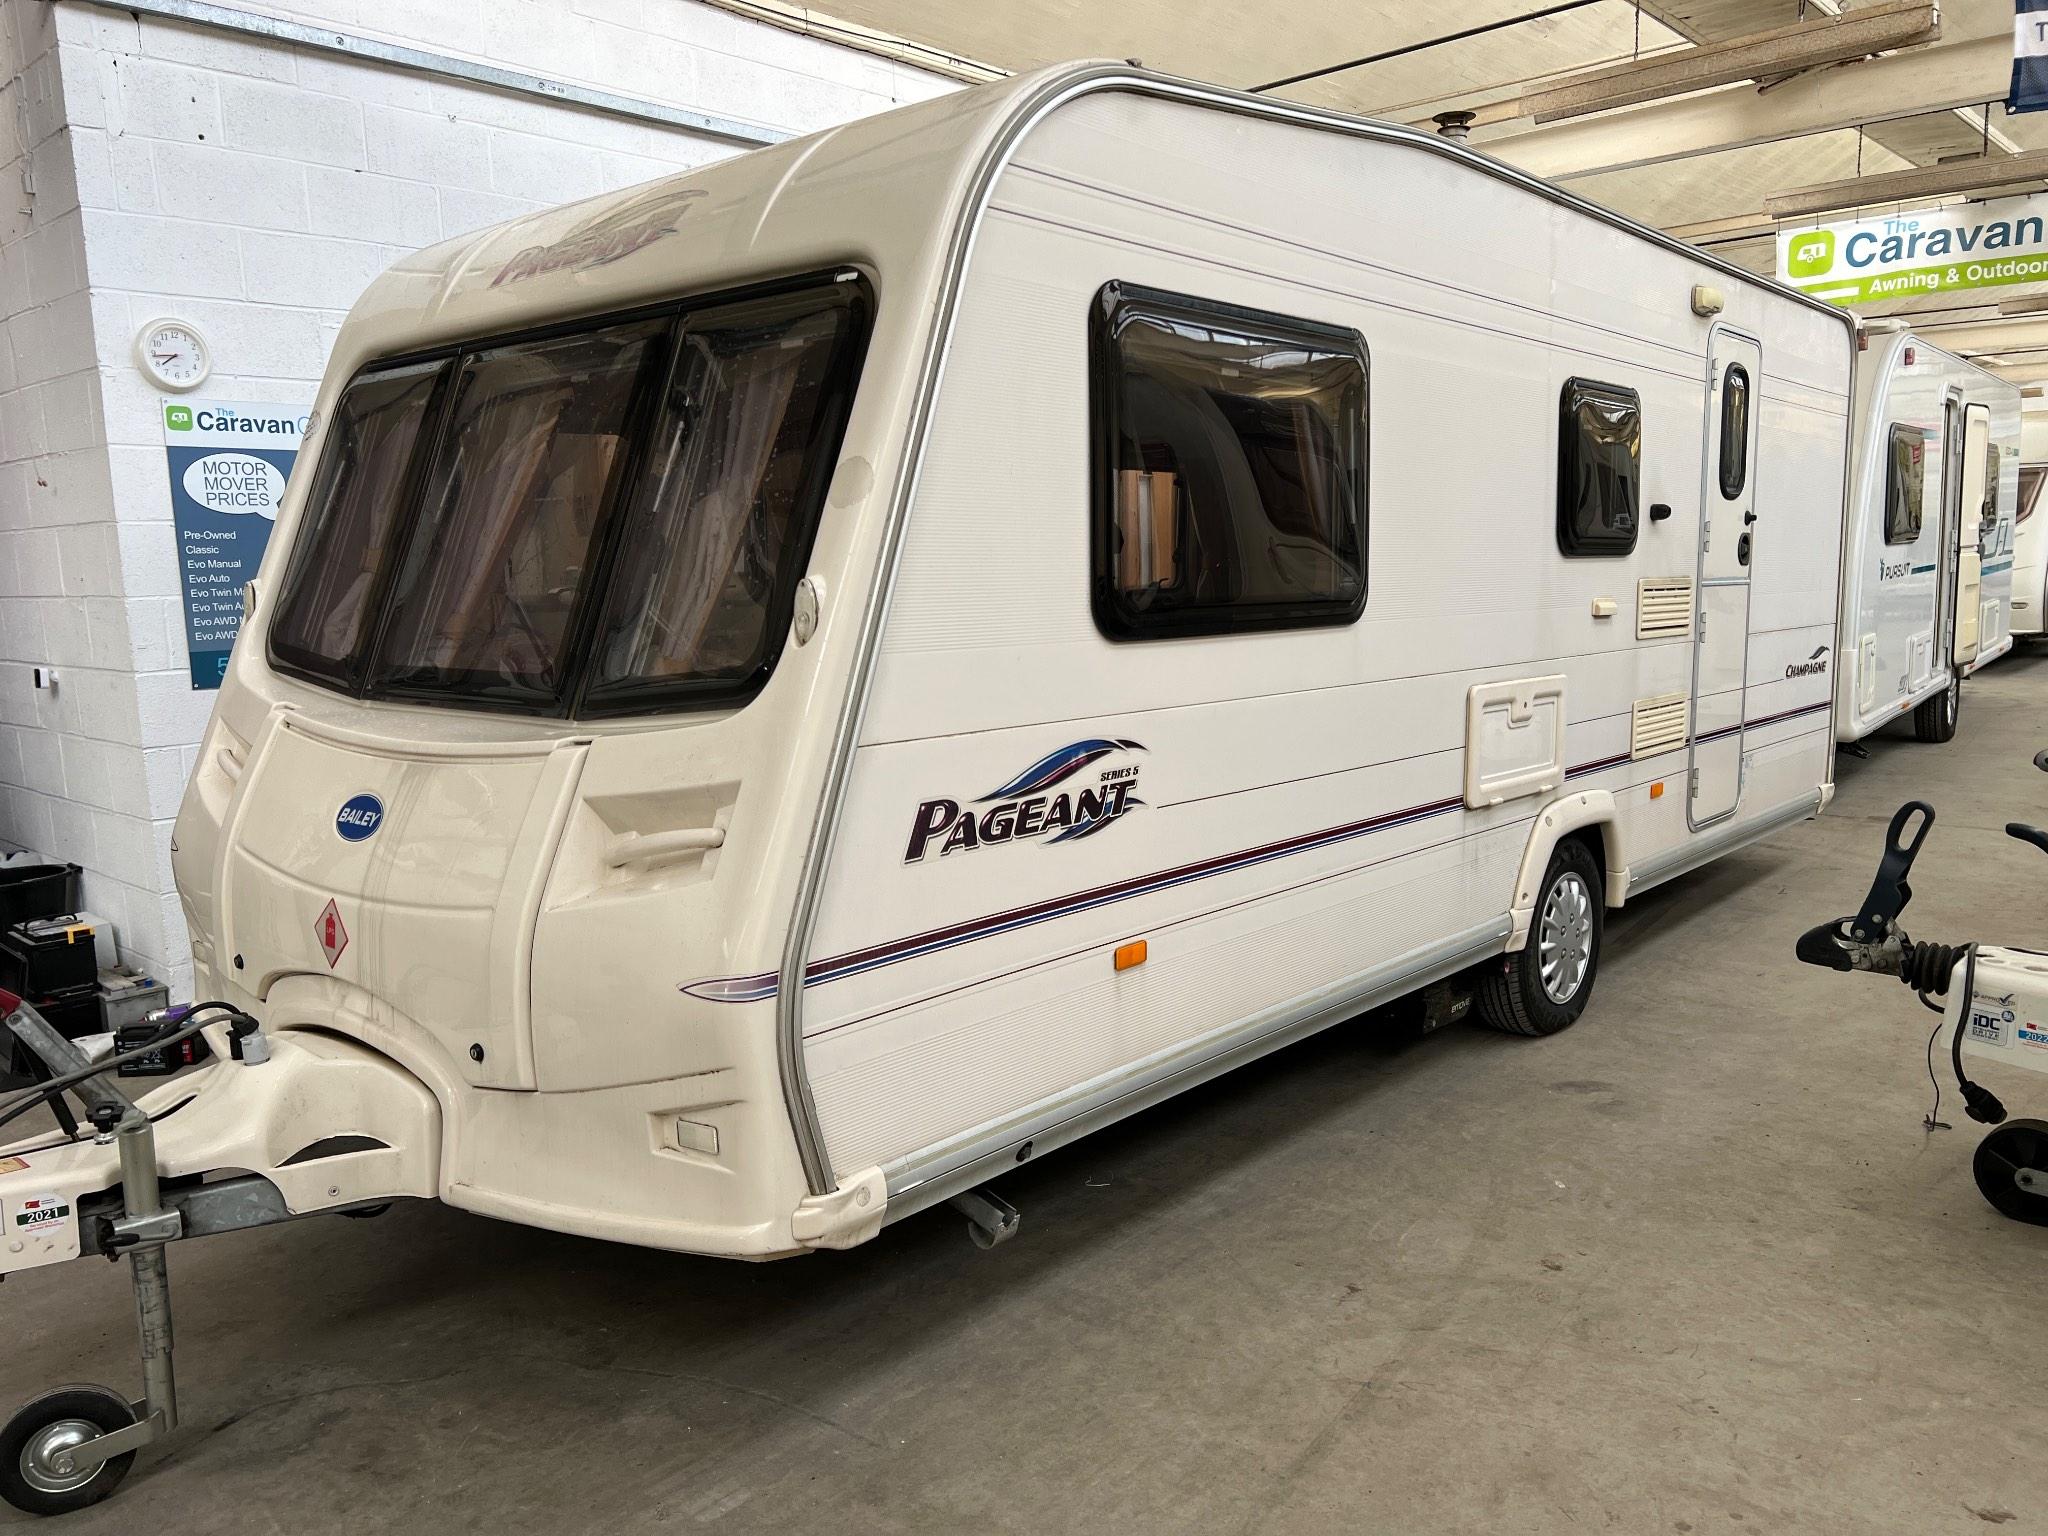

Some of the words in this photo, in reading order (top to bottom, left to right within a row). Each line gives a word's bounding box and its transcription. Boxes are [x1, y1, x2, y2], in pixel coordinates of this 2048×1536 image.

[1884, 220, 1920, 236] The
[1845, 216, 2044, 268] Caravan
[1869, 272, 1939, 294] Awning
[1946, 267, 1960, 283] &
[215, 407, 234, 417] The
[197, 411, 295, 434] Caravan
[203, 461, 267, 476] MOTOR
[204, 477, 269, 491] MOVER
[206, 492, 270, 506] PRICES
[184, 531, 236, 540] Pre-Owned
[185, 545, 220, 554] Classic
[187, 560, 206, 569] Evo
[208, 559, 242, 568] Manual
[1885, 562, 1910, 580] PURSUIT
[189, 575, 207, 583] Evo
[209, 574, 230, 583] Auto
[190, 589, 209, 598] Evo
[210, 588, 232, 597] Twin
[192, 603, 211, 612] Evo
[212, 602, 233, 611] Twin
[193, 617, 212, 627] Evo
[213, 616, 237, 625] AWD
[195, 631, 213, 641] Evo
[215, 631, 238, 640] AWD
[1785, 660, 1827, 679] CHAMPAGNE
[1100, 768, 1131, 781] SERIES
[1132, 765, 1140, 776] 5
[337, 807, 381, 827] BAILEY
[904, 779, 1137, 864] PAGEANT
[2026, 1032, 2048, 1044] 2022
[27, 1207, 59, 1223] 2021
